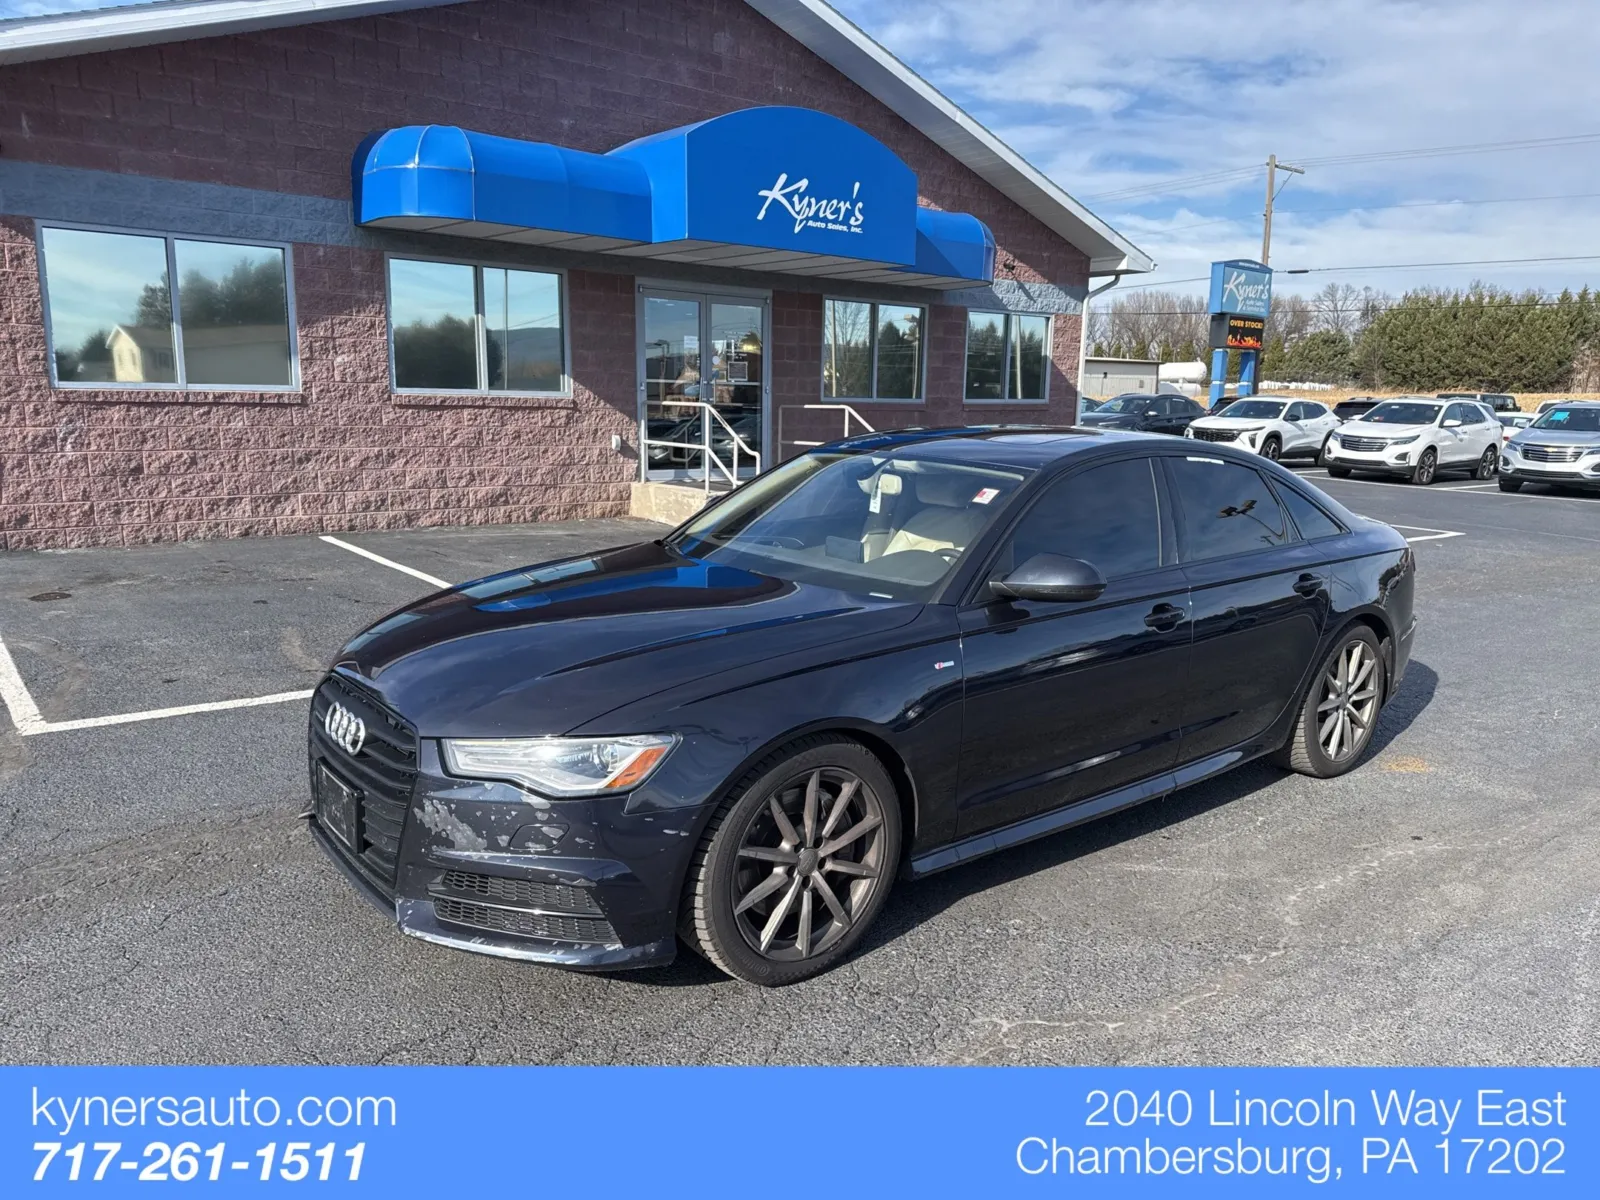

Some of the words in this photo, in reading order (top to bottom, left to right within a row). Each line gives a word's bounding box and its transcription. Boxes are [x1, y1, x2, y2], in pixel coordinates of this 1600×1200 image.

[757, 173, 864, 234] Kyner's
[807, 220, 826, 228] Auto
[827, 222, 849, 232] Sales,
[1222, 271, 1270, 312] Kyner's
